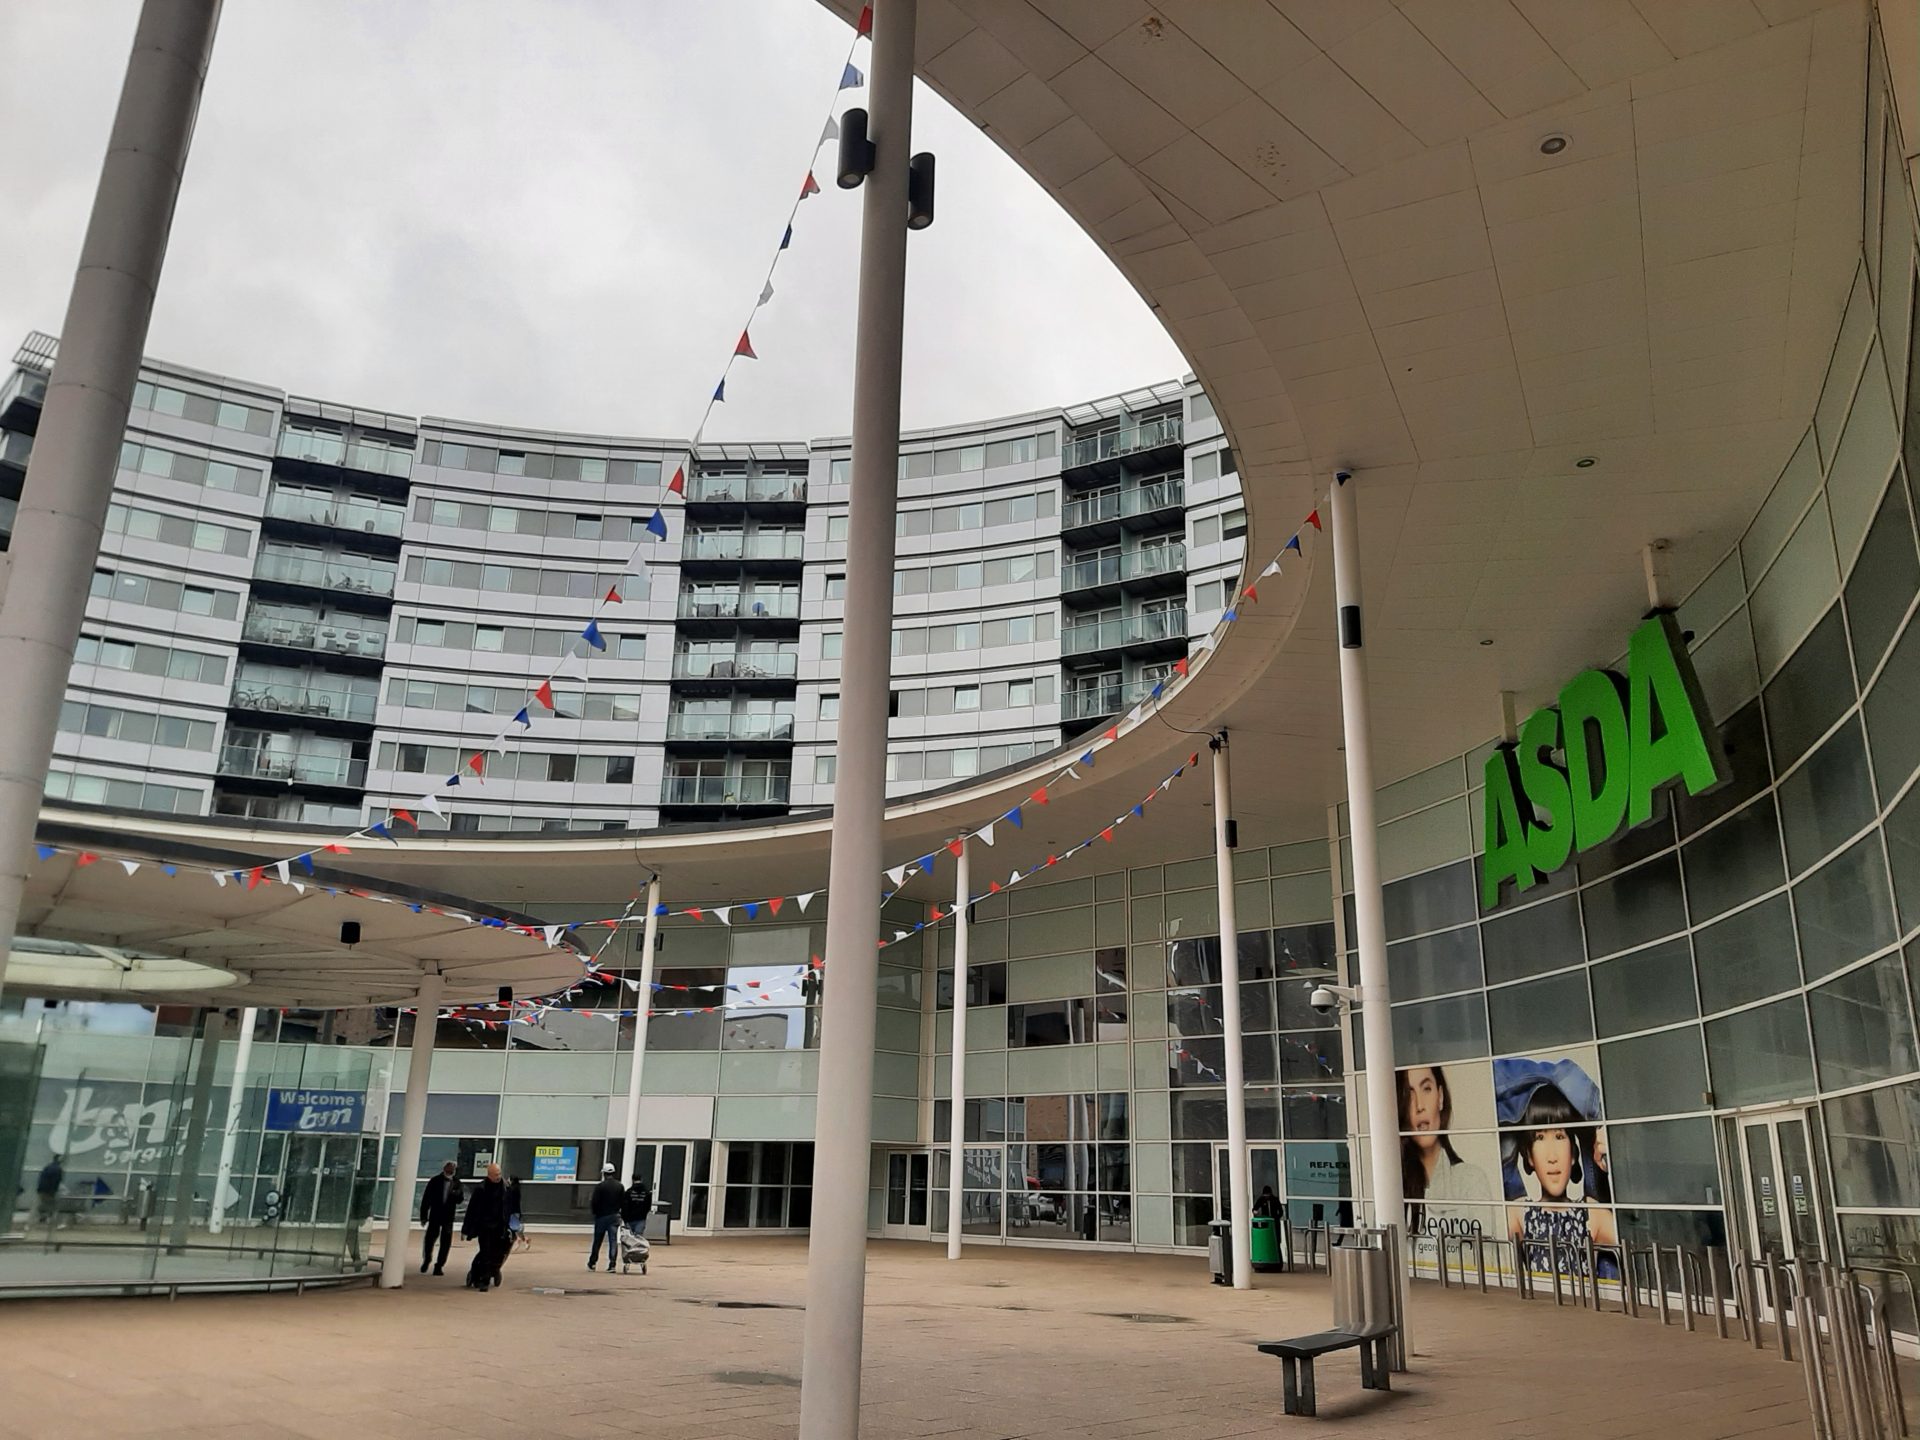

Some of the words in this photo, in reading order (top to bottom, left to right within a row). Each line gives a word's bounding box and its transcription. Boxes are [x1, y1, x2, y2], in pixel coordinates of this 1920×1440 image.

[1483, 618, 1719, 910] ASDA
[281, 1091, 355, 1106] Welcome
[548, 1148, 560, 1156] LET
[1309, 1161, 1350, 1169] REFLEX
